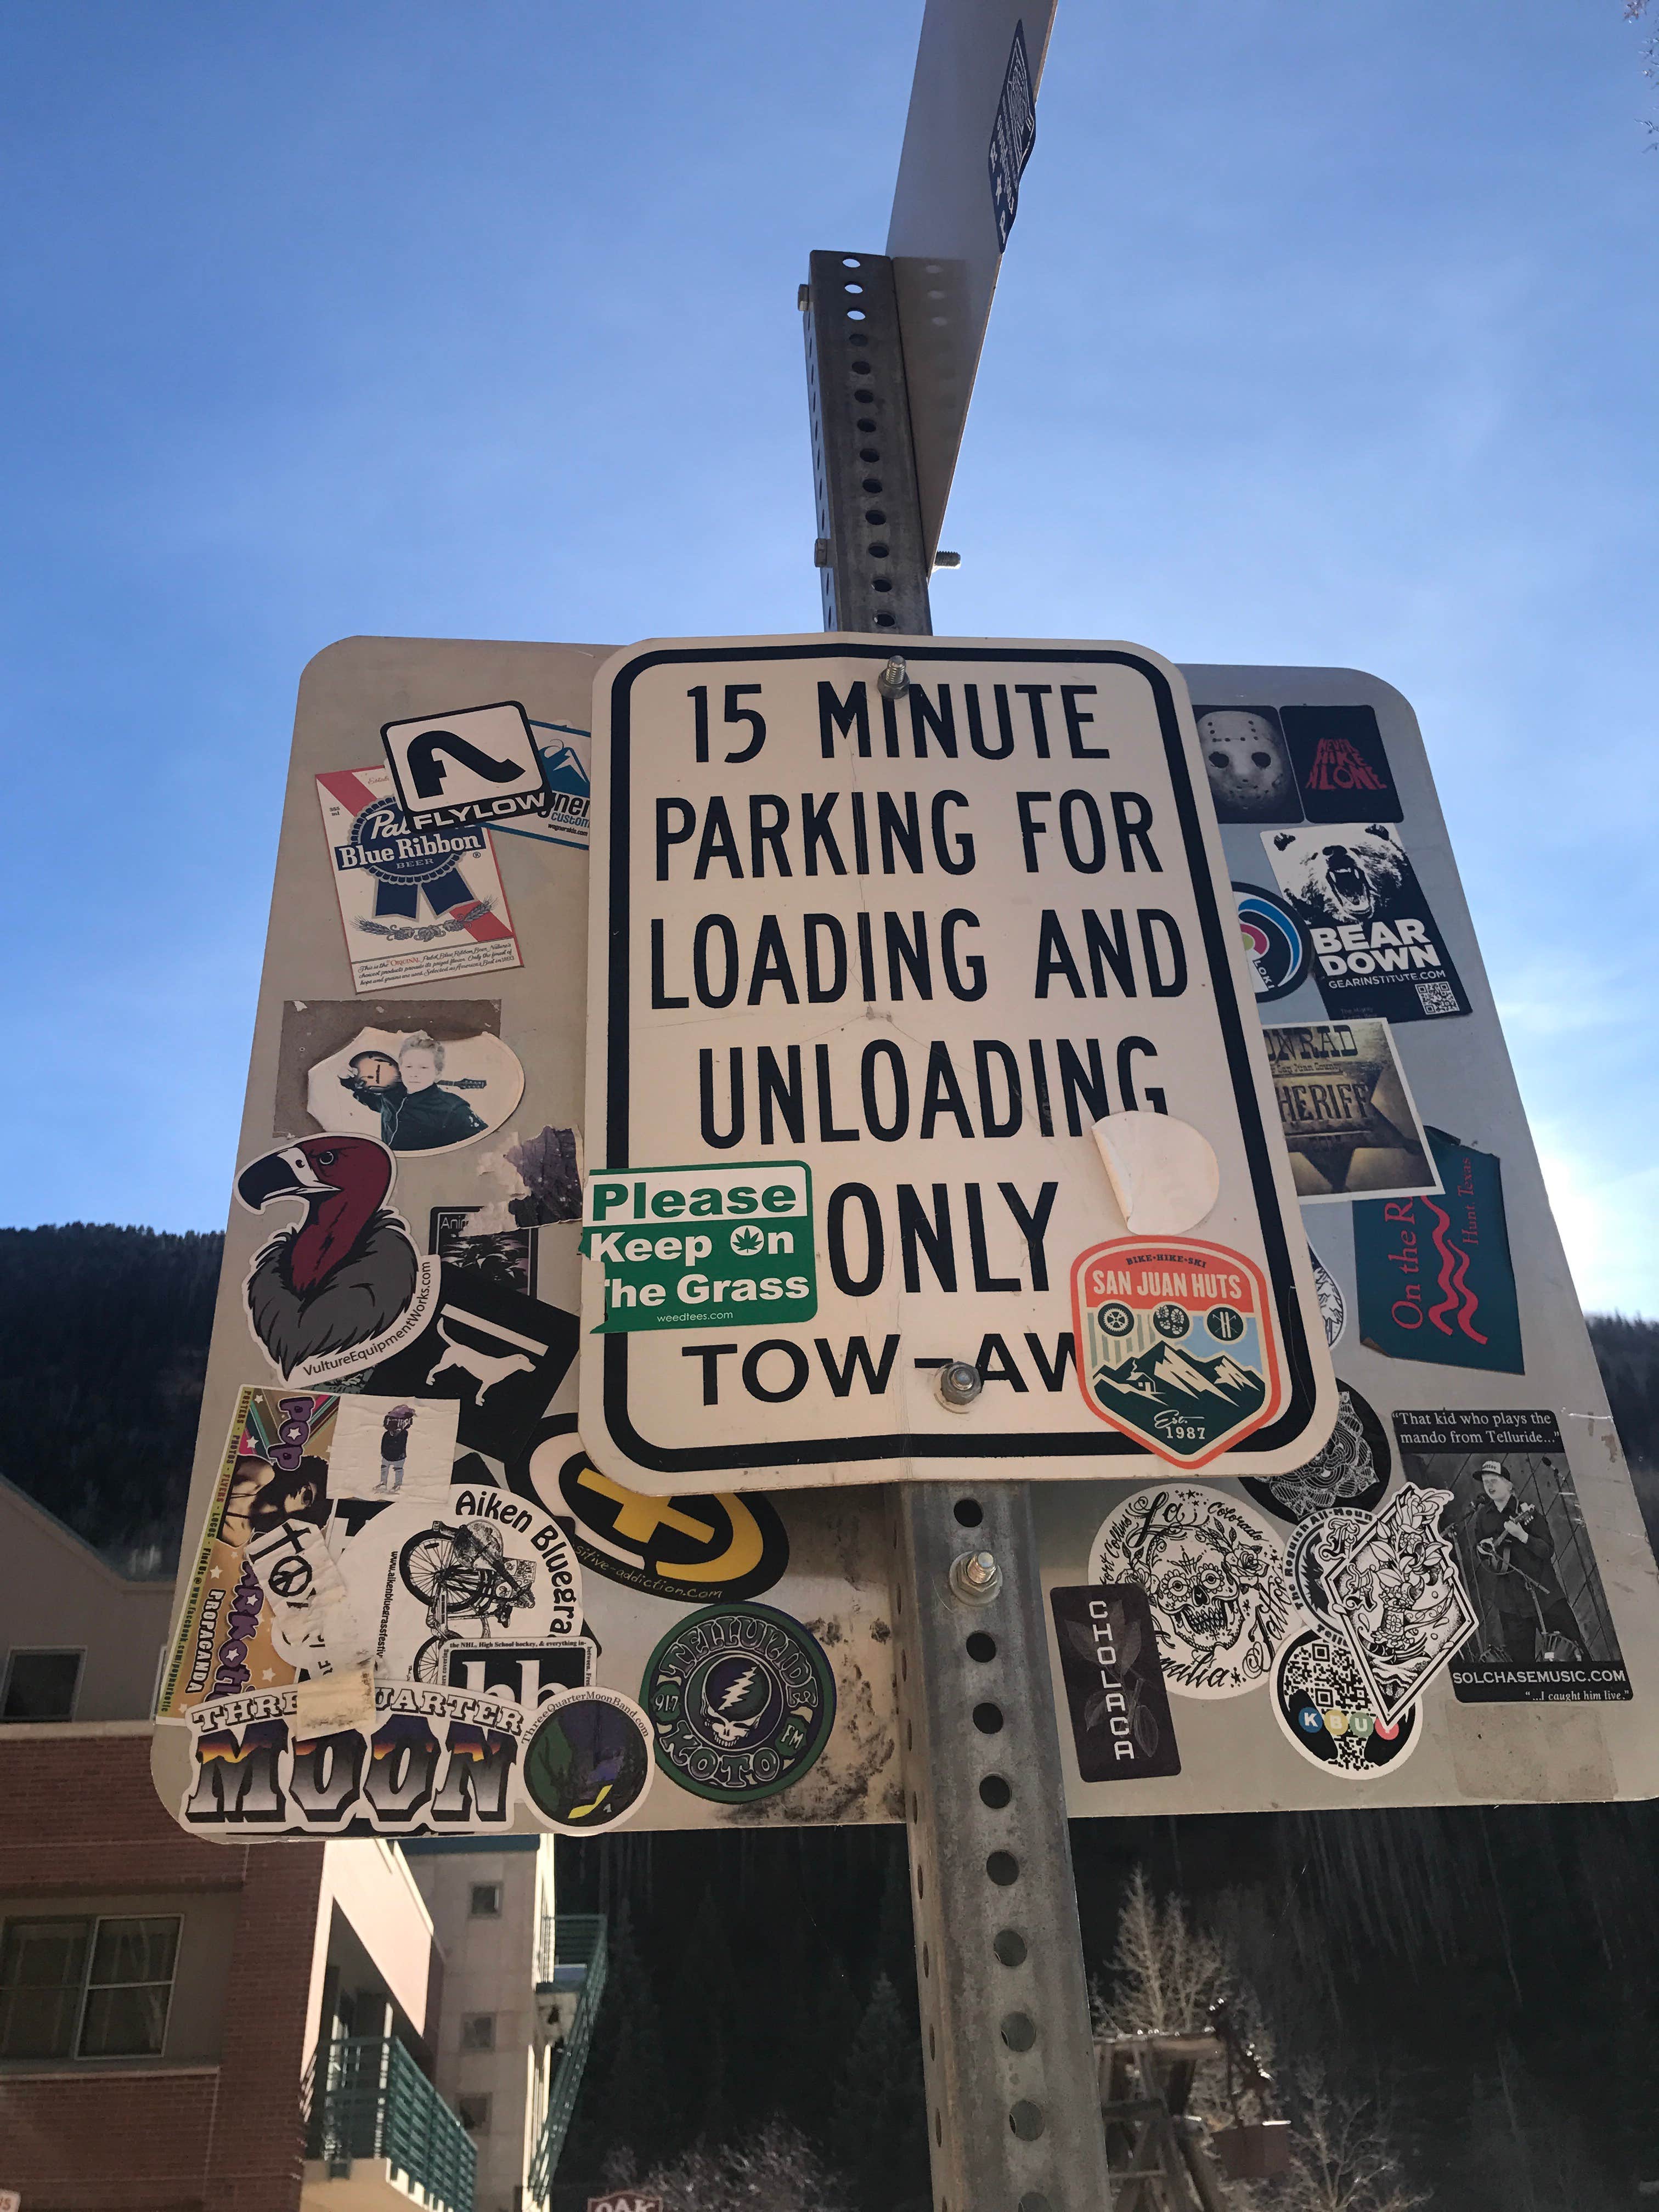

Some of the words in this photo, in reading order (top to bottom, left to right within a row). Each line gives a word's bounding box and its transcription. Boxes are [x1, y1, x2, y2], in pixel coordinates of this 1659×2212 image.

[687, 684, 767, 763] 15
[817, 680, 1110, 760] MINUTE
[1305, 763, 1387, 790] ALONE
[1314, 751, 1368, 766] HIKE
[413, 792, 545, 830] FLYLOW
[338, 845, 395, 868] Blue
[396, 833, 481, 860] Ribbon
[656, 789, 975, 882] PARKING
[1016, 789, 1163, 874] FOR
[397, 857, 435, 870] BEER
[1310, 918, 1431, 954] BEAR
[651, 909, 988, 1009] LOADING
[1035, 909, 1188, 998] AND
[1253, 959, 1274, 989] LOKI
[1319, 944, 1441, 977] DOWN
[1328, 970, 1446, 989] GEARINSTITUTE.COM
[698, 1035, 1167, 1149] UNLOADING
[1457, 1157, 1474, 1197] Texas
[593, 1182, 797, 1222] Please
[590, 1231, 713, 1267] Keep
[827, 1181, 1059, 1297] ONLY
[1387, 1229, 1419, 1274] the
[604, 1278, 667, 1308] he
[676, 1274, 810, 1305] Grass
[1092, 1269, 1132, 1295] SAN
[1137, 1271, 1188, 1297] JUAN
[1191, 1273, 1242, 1300] HUTS
[303, 1261, 431, 1375] VultureEquipmentWorks.com
[657, 1311, 733, 1323] weedtees.com
[1391, 1284, 1423, 1329] On
[1165, 1426, 1205, 1440] 1987
[1400, 1431, 1446, 1443] mando
[1450, 1430, 1483, 1443] from
[1434, 1412, 1457, 1424] kid
[1459, 1412, 1489, 1424] who
[1492, 1413, 1527, 1427] plays
[1531, 1412, 1552, 1424] the
[226, 1435, 240, 1464] PHOTOS
[216, 1473, 230, 1503] FLYERS
[207, 1512, 221, 1538] LOGOS
[1104, 1514, 1133, 1559] Collins
[1207, 1502, 1269, 1542] Colorado
[455, 1490, 533, 1533] Aiken
[530, 1525, 577, 1638] Bluegra
[1284, 1523, 1310, 1577] Roguish
[1288, 1583, 1304, 1610] The
[185, 1589, 225, 1694] PROPAGANDA
[658, 1615, 819, 1707] TELLURIDE
[1453, 1670, 1627, 1684] SOLCHASEMUSIC.COM
[1088, 1601, 1135, 1760] CHOLACA
[1548, 1691, 1581, 1701] caught
[1583, 1691, 1601, 1701] him
[521, 1690, 649, 1745] ThreeQuarterMoonBand.com
[1304, 1712, 1390, 1734] KBU
[659, 1719, 780, 1788] KOTO
[780, 1724, 804, 1750] FM
[187, 1714, 518, 1823] MOON
